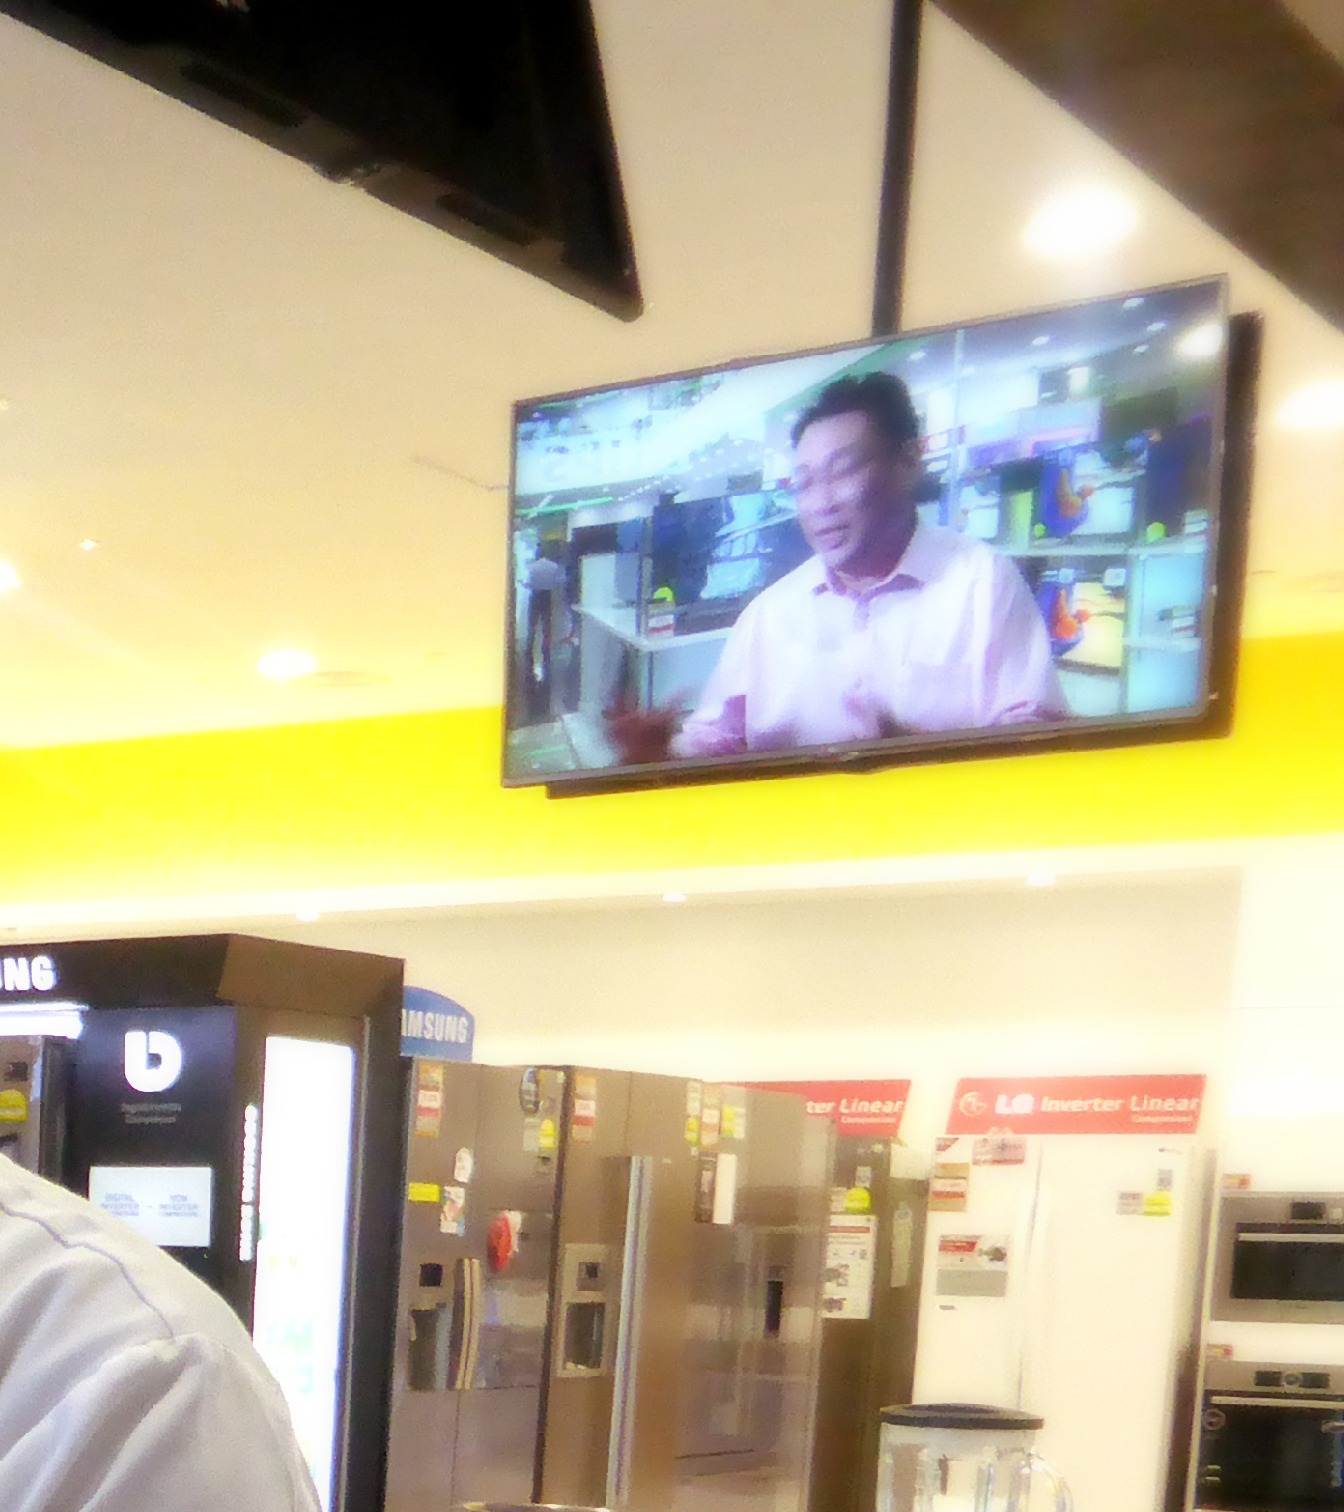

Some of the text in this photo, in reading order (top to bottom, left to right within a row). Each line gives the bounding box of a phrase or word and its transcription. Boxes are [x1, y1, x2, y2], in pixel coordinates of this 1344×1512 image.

[839, 1098, 904, 1113] Linear
[995, 1094, 1199, 1114] LG Inverter Linear
